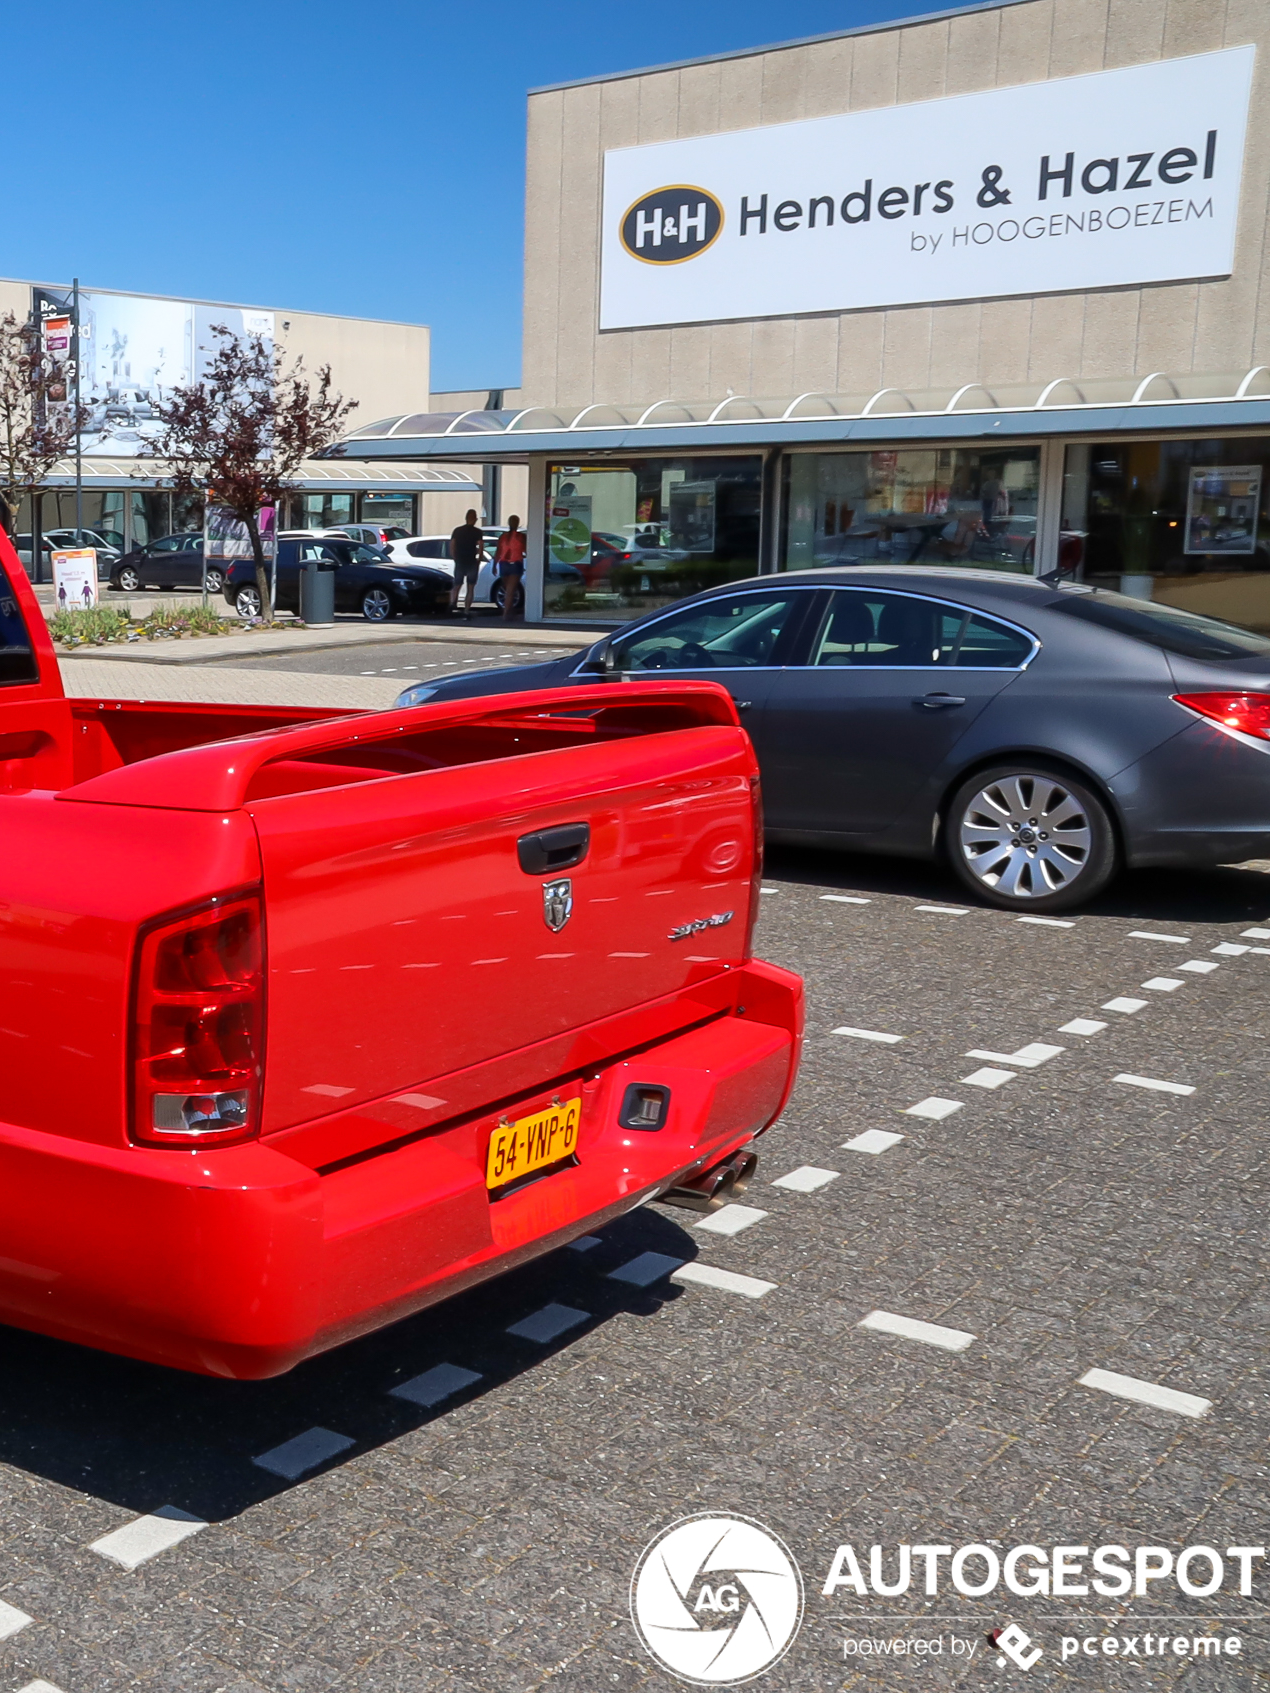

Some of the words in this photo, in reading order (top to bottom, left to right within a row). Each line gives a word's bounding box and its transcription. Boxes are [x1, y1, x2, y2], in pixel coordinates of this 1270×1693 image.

[739, 178, 955, 237] Henders
[976, 164, 1013, 209] &
[1037, 128, 1218, 201] Hazel
[635, 202, 707, 248] H&H
[910, 230, 944, 256] by
[951, 196, 1214, 248] HOOGENBOEZEM
[494, 1108, 576, 1178] 54-VNP-6
